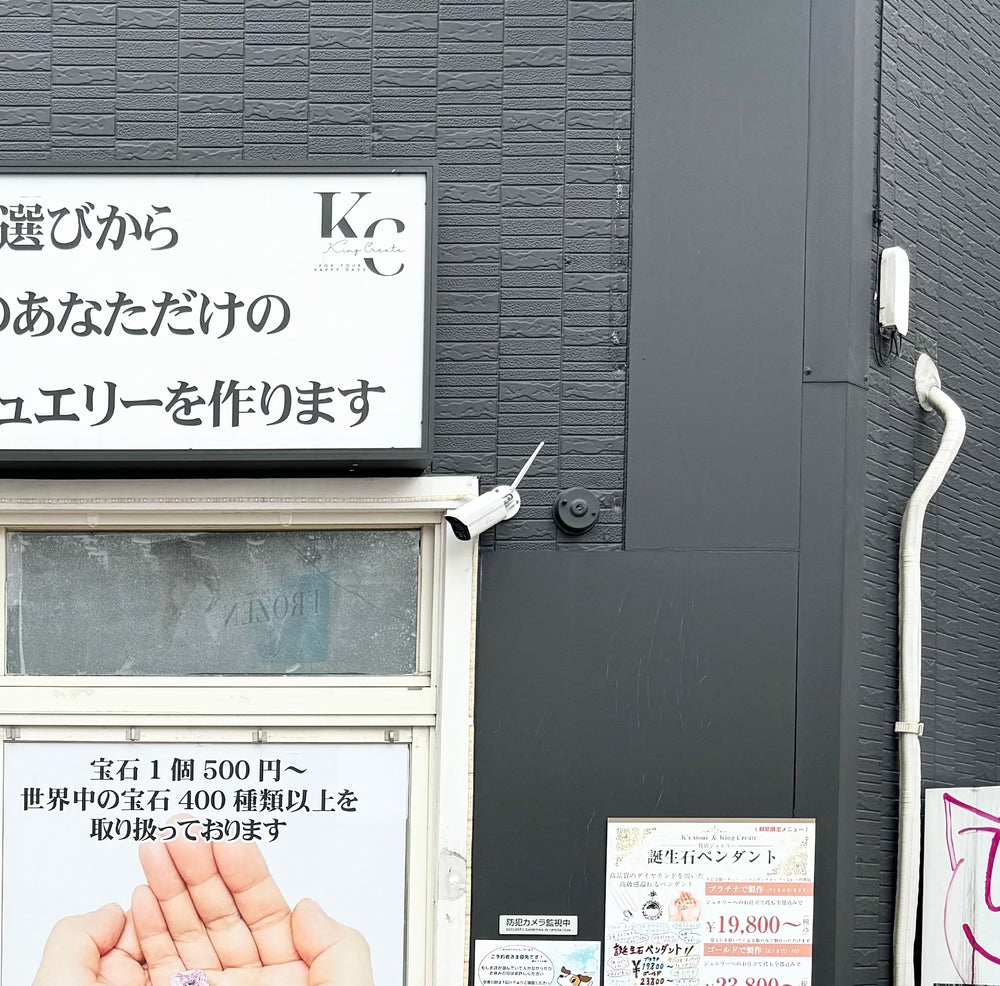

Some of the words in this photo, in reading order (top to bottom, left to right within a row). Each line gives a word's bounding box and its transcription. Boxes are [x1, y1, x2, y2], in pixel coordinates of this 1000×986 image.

[91, 758, 139, 780] 宝石
[150, 759, 162, 780] 1
[171, 758, 194, 781] 個
[204, 760, 249, 779] 500
[22, 787, 171, 813] 世界中の宝石
[179, 790, 225, 810] 400
[233, 788, 358, 814] 種類以上を
[90, 818, 287, 842] 取り扱っております
[648, 850, 775, 864] 誕生石ペンダント
[506, 918, 571, 927] 防犯カメラ監視中
[707, 946, 761, 955] ゴールドで製作
